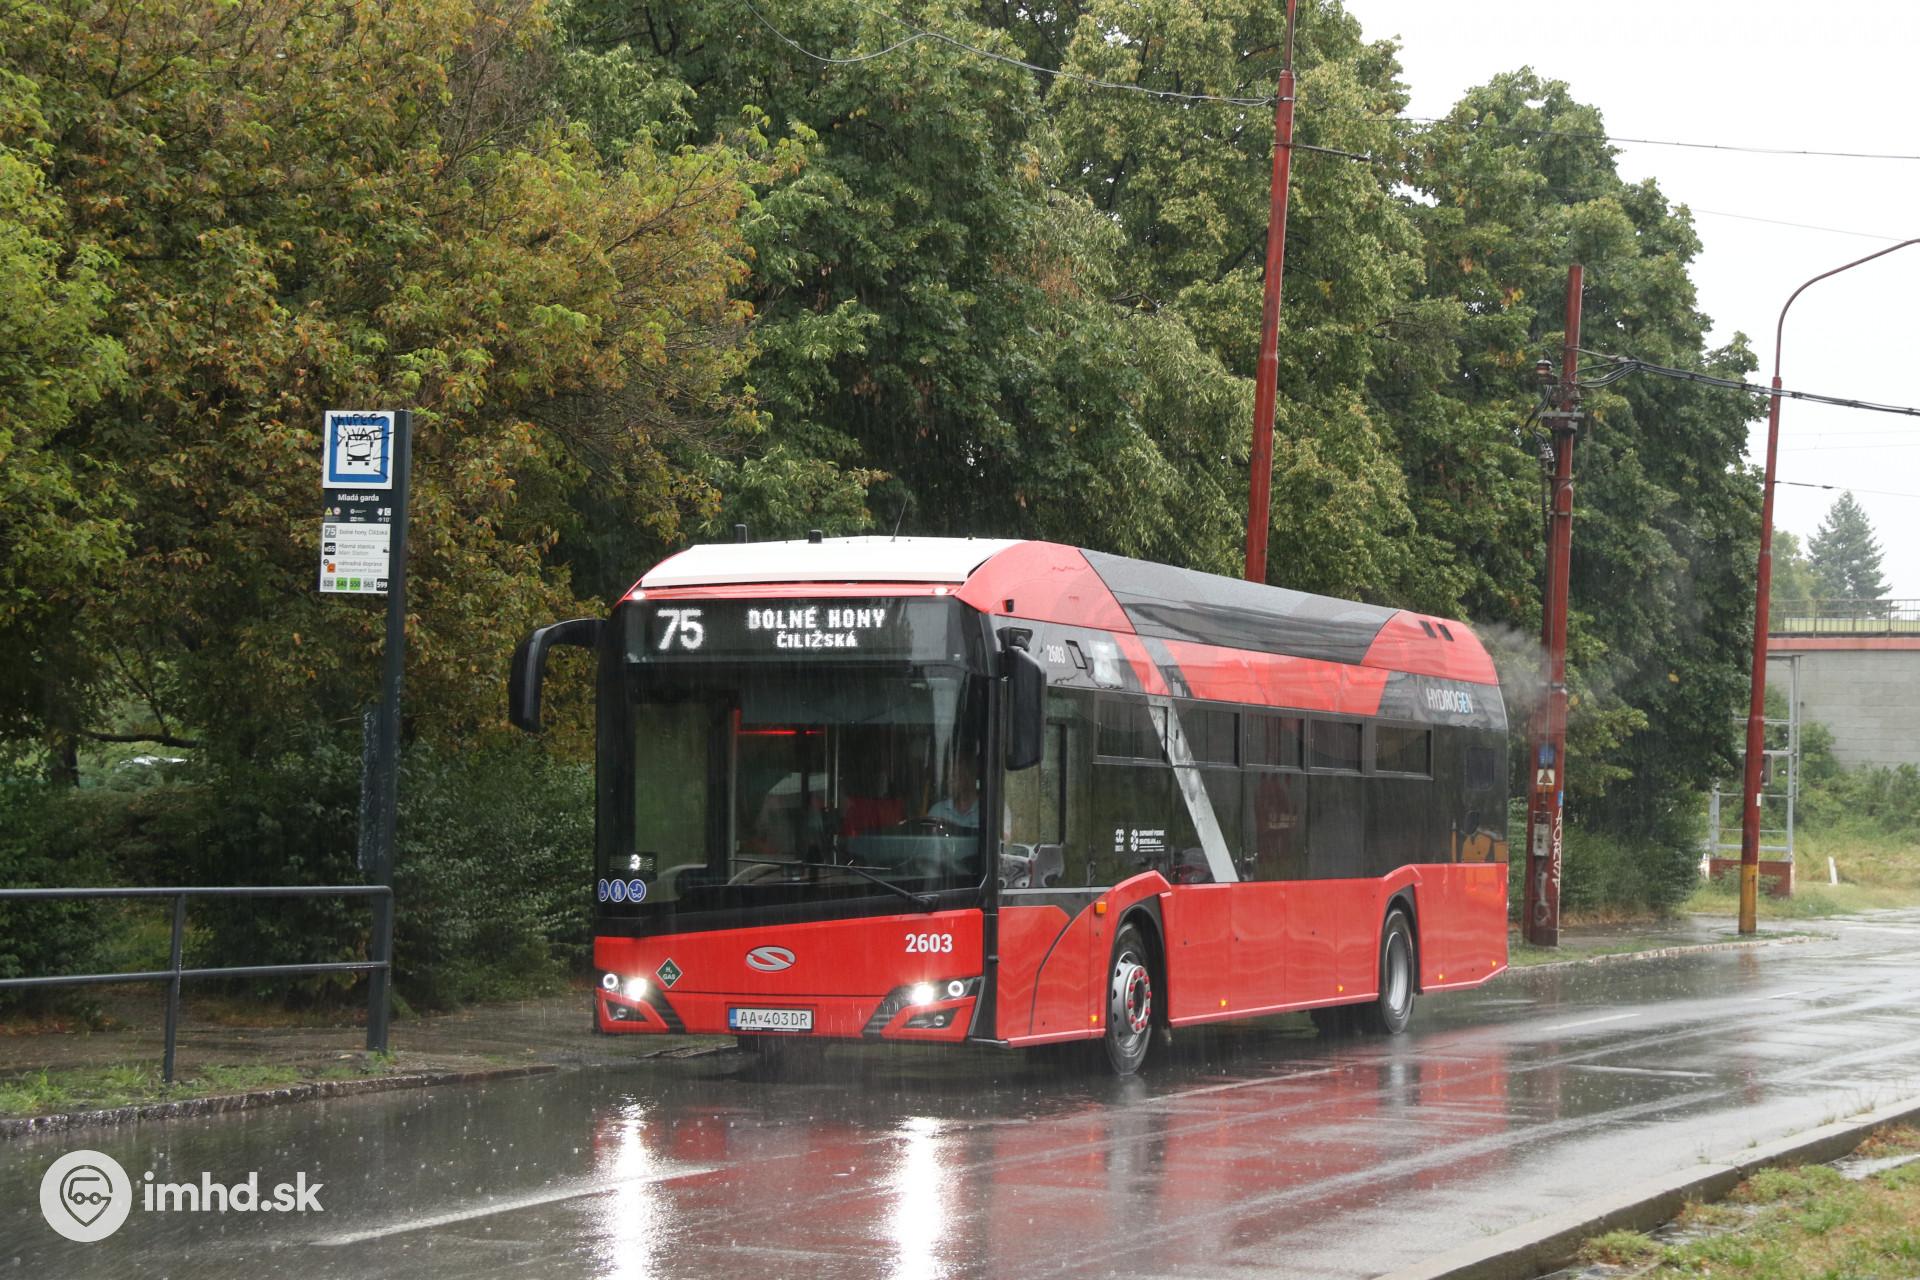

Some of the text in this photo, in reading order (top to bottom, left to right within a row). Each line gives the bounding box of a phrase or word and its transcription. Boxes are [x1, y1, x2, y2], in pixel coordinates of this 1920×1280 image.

[337, 493, 380, 503] Mladá garda
[326, 527, 336, 536] 75
[747, 605, 887, 630] DOLNÉ HONY
[657, 608, 704, 650] 75
[776, 628, 858, 648] ČILIŽSKÁ
[1426, 687, 1474, 714] HYDROGEN
[905, 933, 953, 953] 2603
